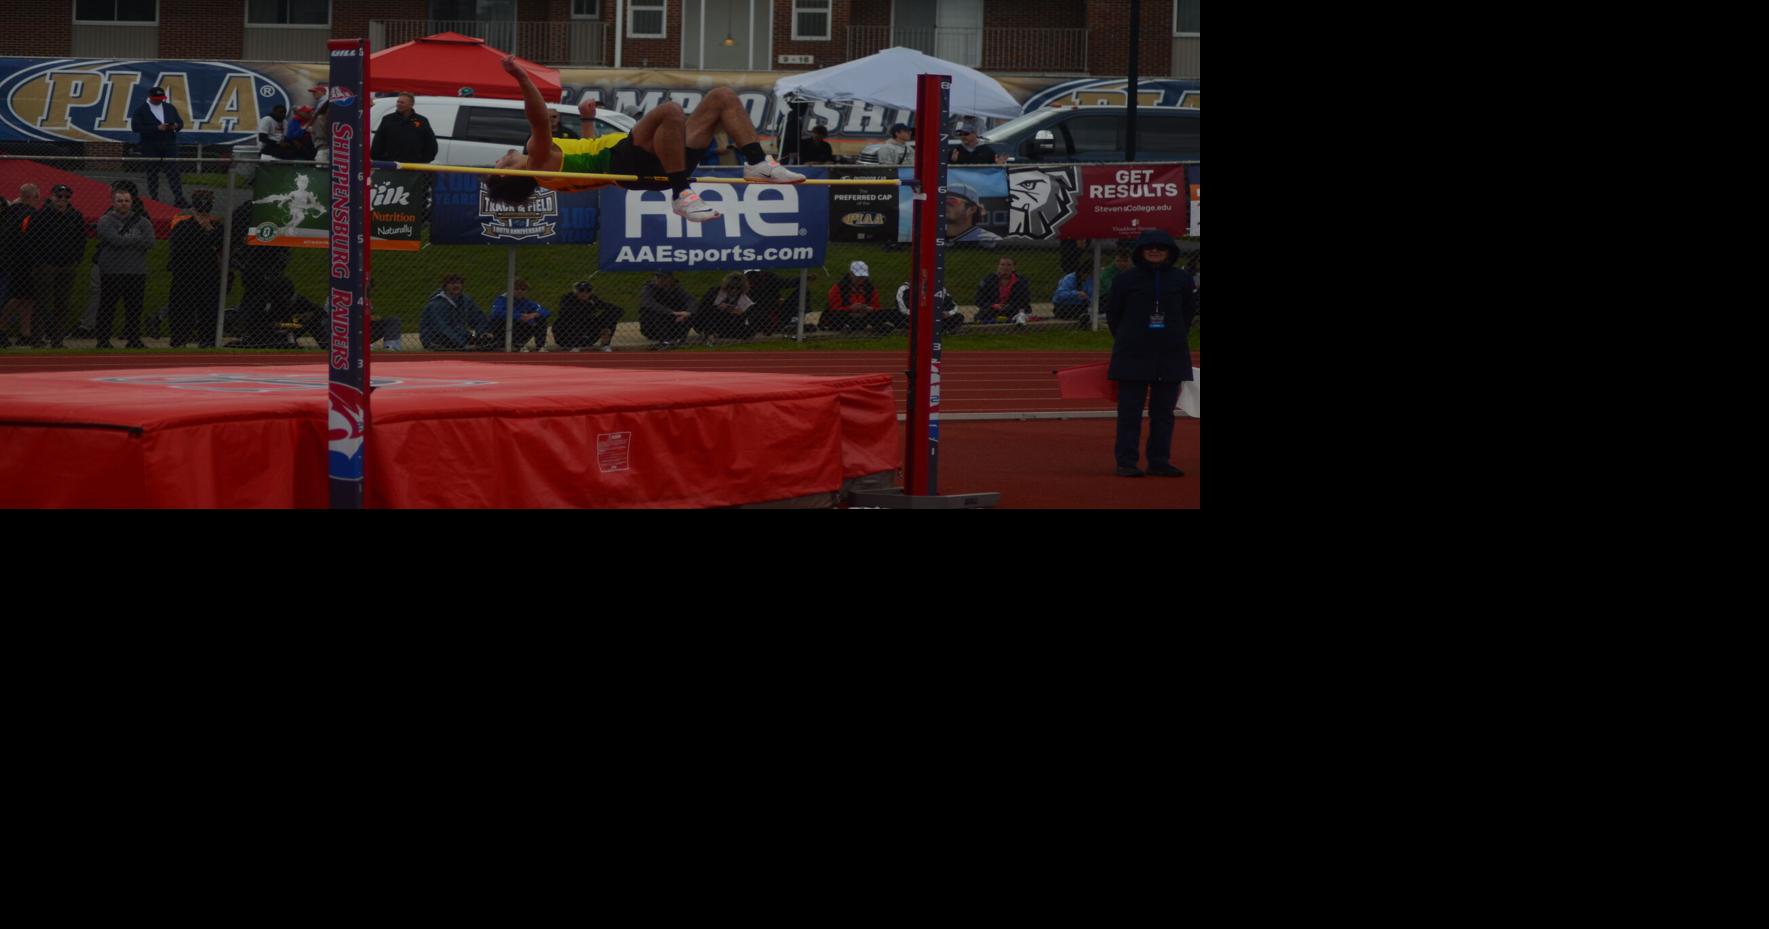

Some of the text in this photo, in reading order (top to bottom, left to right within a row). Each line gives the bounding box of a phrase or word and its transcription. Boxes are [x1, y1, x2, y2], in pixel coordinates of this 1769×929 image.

[36, 71, 260, 133] PIAA
[357, 172, 363, 181] 6
[1115, 169, 1154, 184] GET
[1089, 182, 1179, 199] RESULTS
[331, 121, 353, 280] SHIPPENSBURG
[1094, 203, 1172, 213] StevensCollege.edu
[372, 211, 416, 222] Nutrition
[846, 212, 885, 225] PIAA
[357, 234, 364, 244] 5
[377, 225, 412, 239] Naturally
[615, 245, 814, 265] AAEsports.com
[331, 288, 353, 371] RAIDERS
